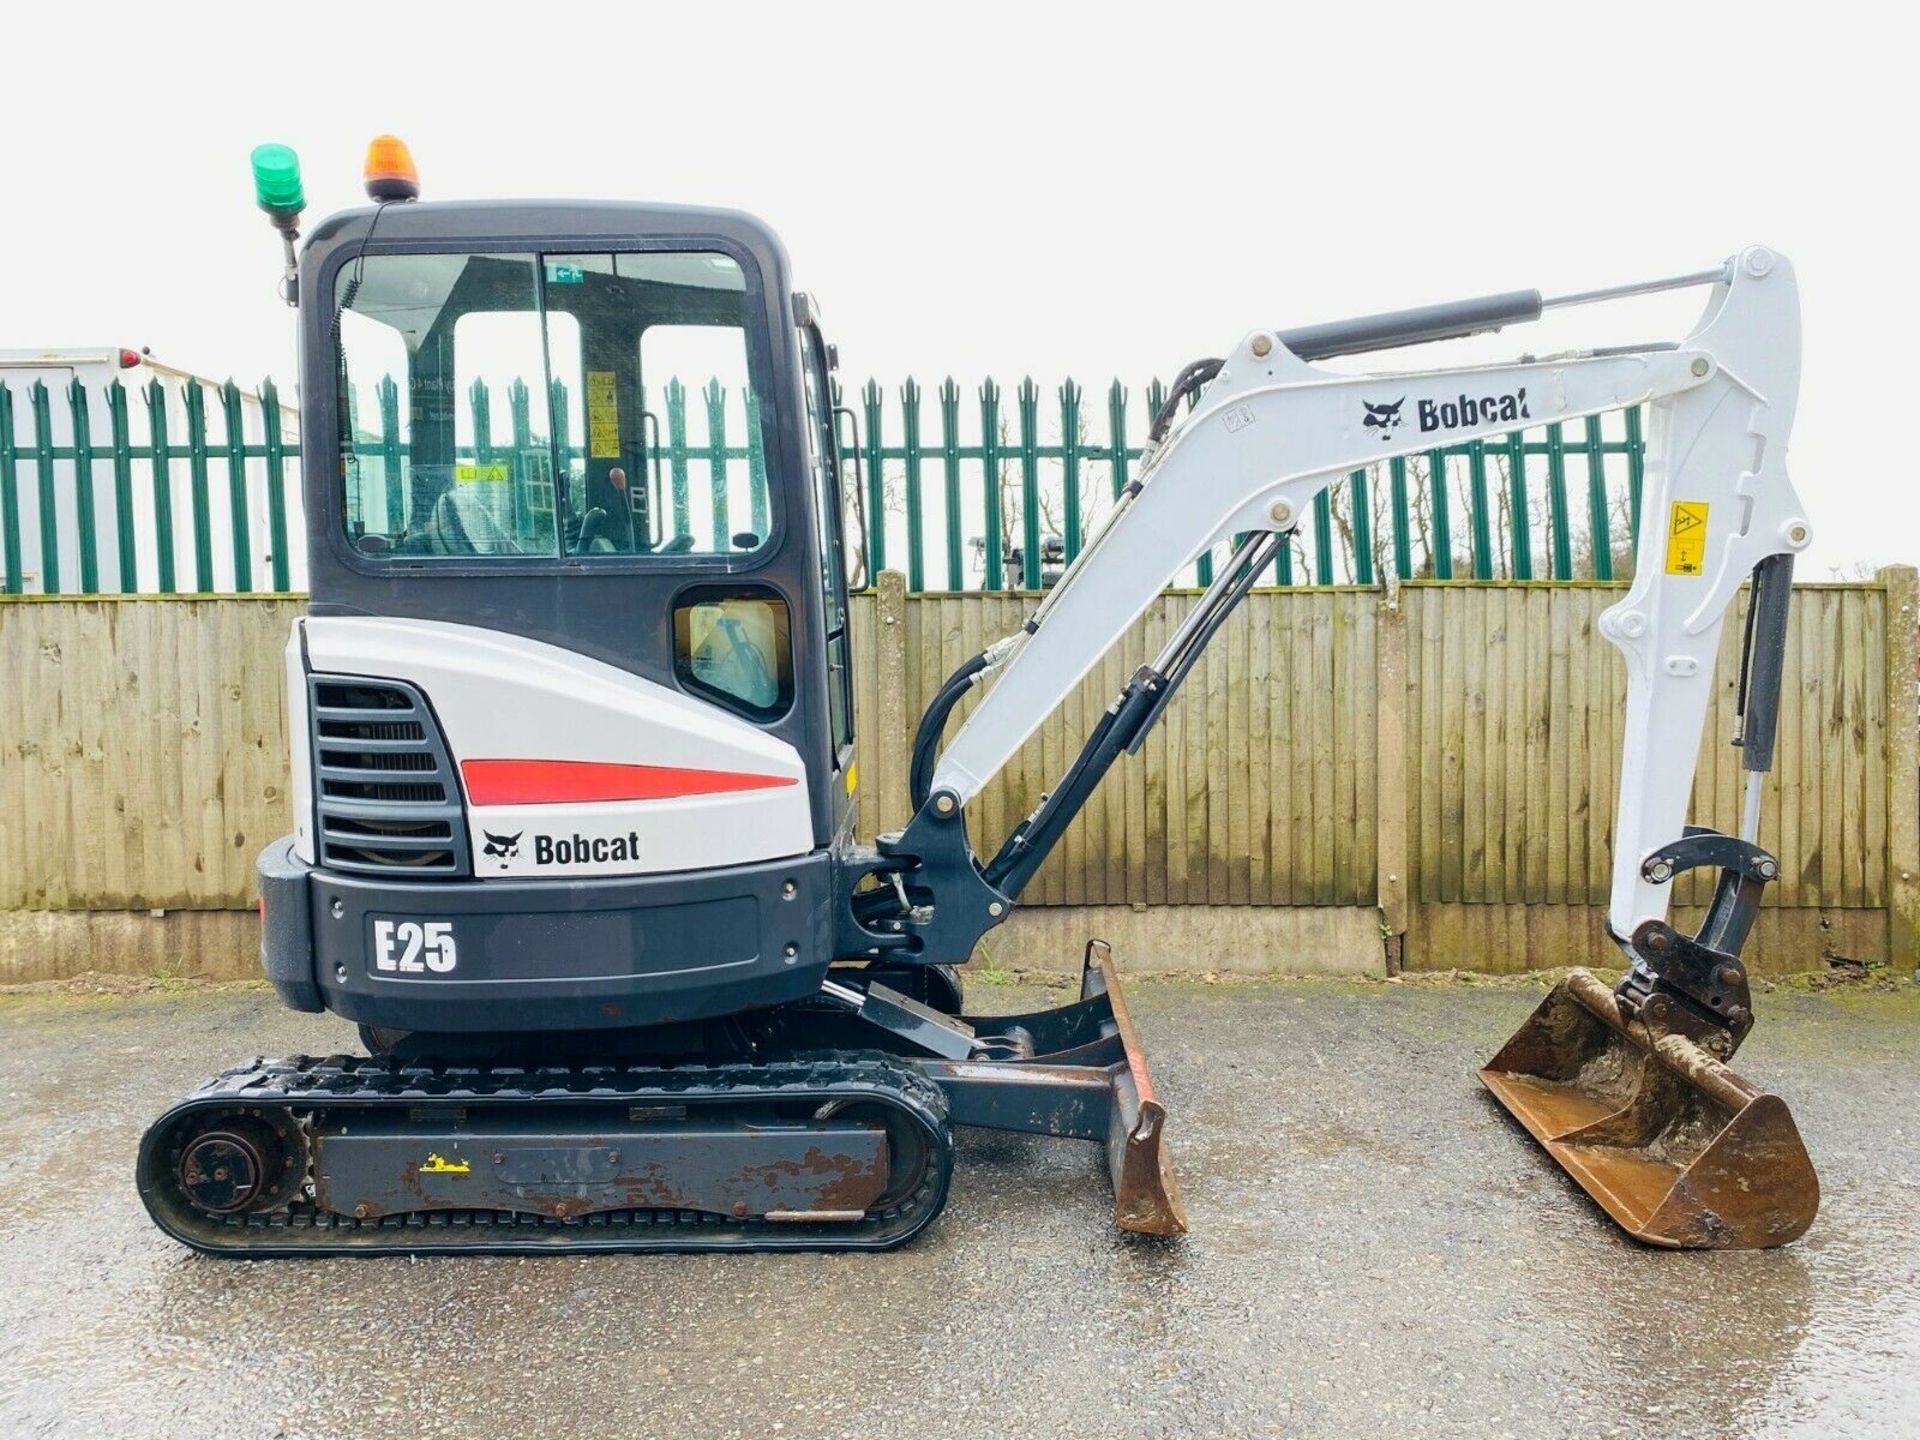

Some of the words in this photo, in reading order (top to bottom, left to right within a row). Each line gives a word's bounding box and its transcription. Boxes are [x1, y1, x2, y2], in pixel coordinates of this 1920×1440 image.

[1418, 387, 1530, 432] Bobcat
[534, 832, 640, 865] Bobcat
[374, 920, 457, 973] E25
